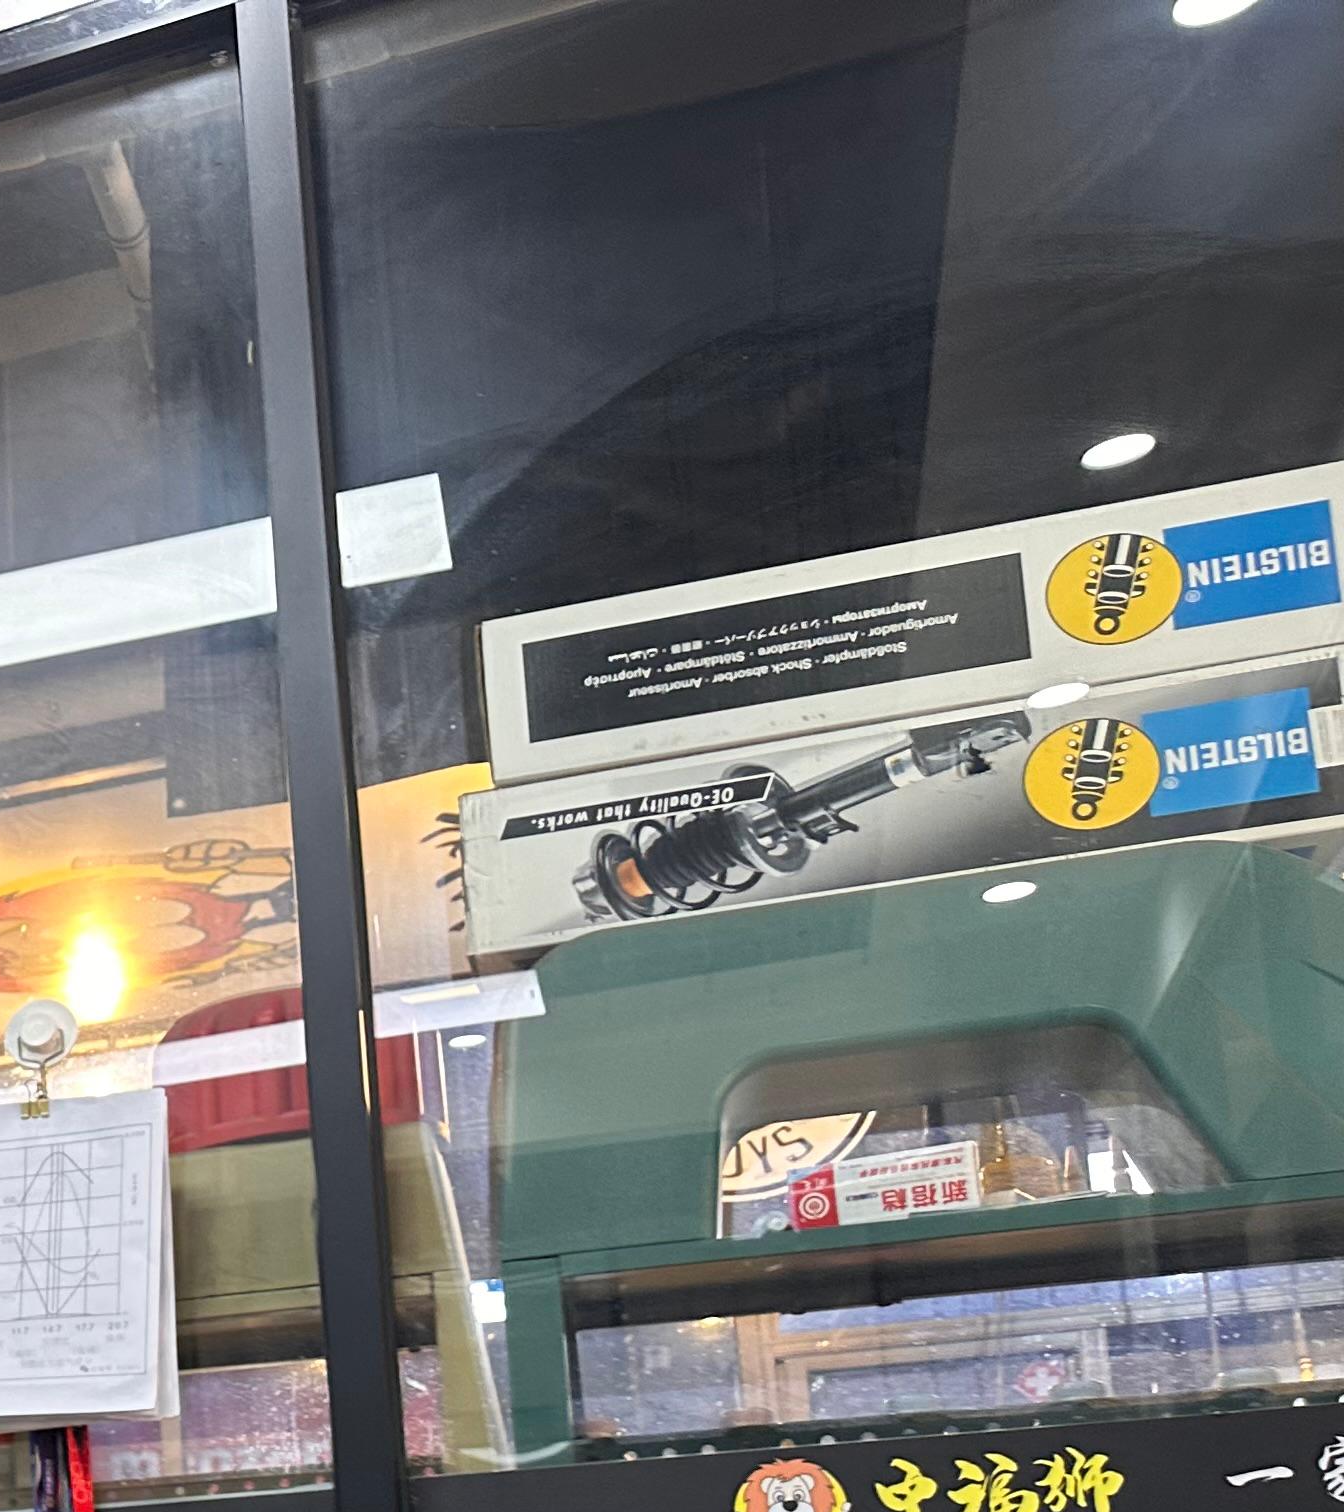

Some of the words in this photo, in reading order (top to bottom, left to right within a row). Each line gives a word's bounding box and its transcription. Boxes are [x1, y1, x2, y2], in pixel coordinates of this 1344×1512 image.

[1187, 539, 1331, 587] BILSTEIN
[831, 600, 927, 624] Амортизаторы
[867, 613, 958, 638] Amortiguador
[758, 630, 859, 656] Ammortizzatore
[822, 641, 908, 664] Stoßdämpfer
[664, 651, 746, 673] Stötdämpare
[712, 664, 770, 683] absorber
[772, 657, 813, 675] Shock
[628, 677, 702, 698] Amortisseur
[1163, 727, 1309, 775] BILSTEIN
[639, 787, 735, 813] OE-Quality
[531, 811, 589, 832] works.
[596, 803, 631, 822] that
